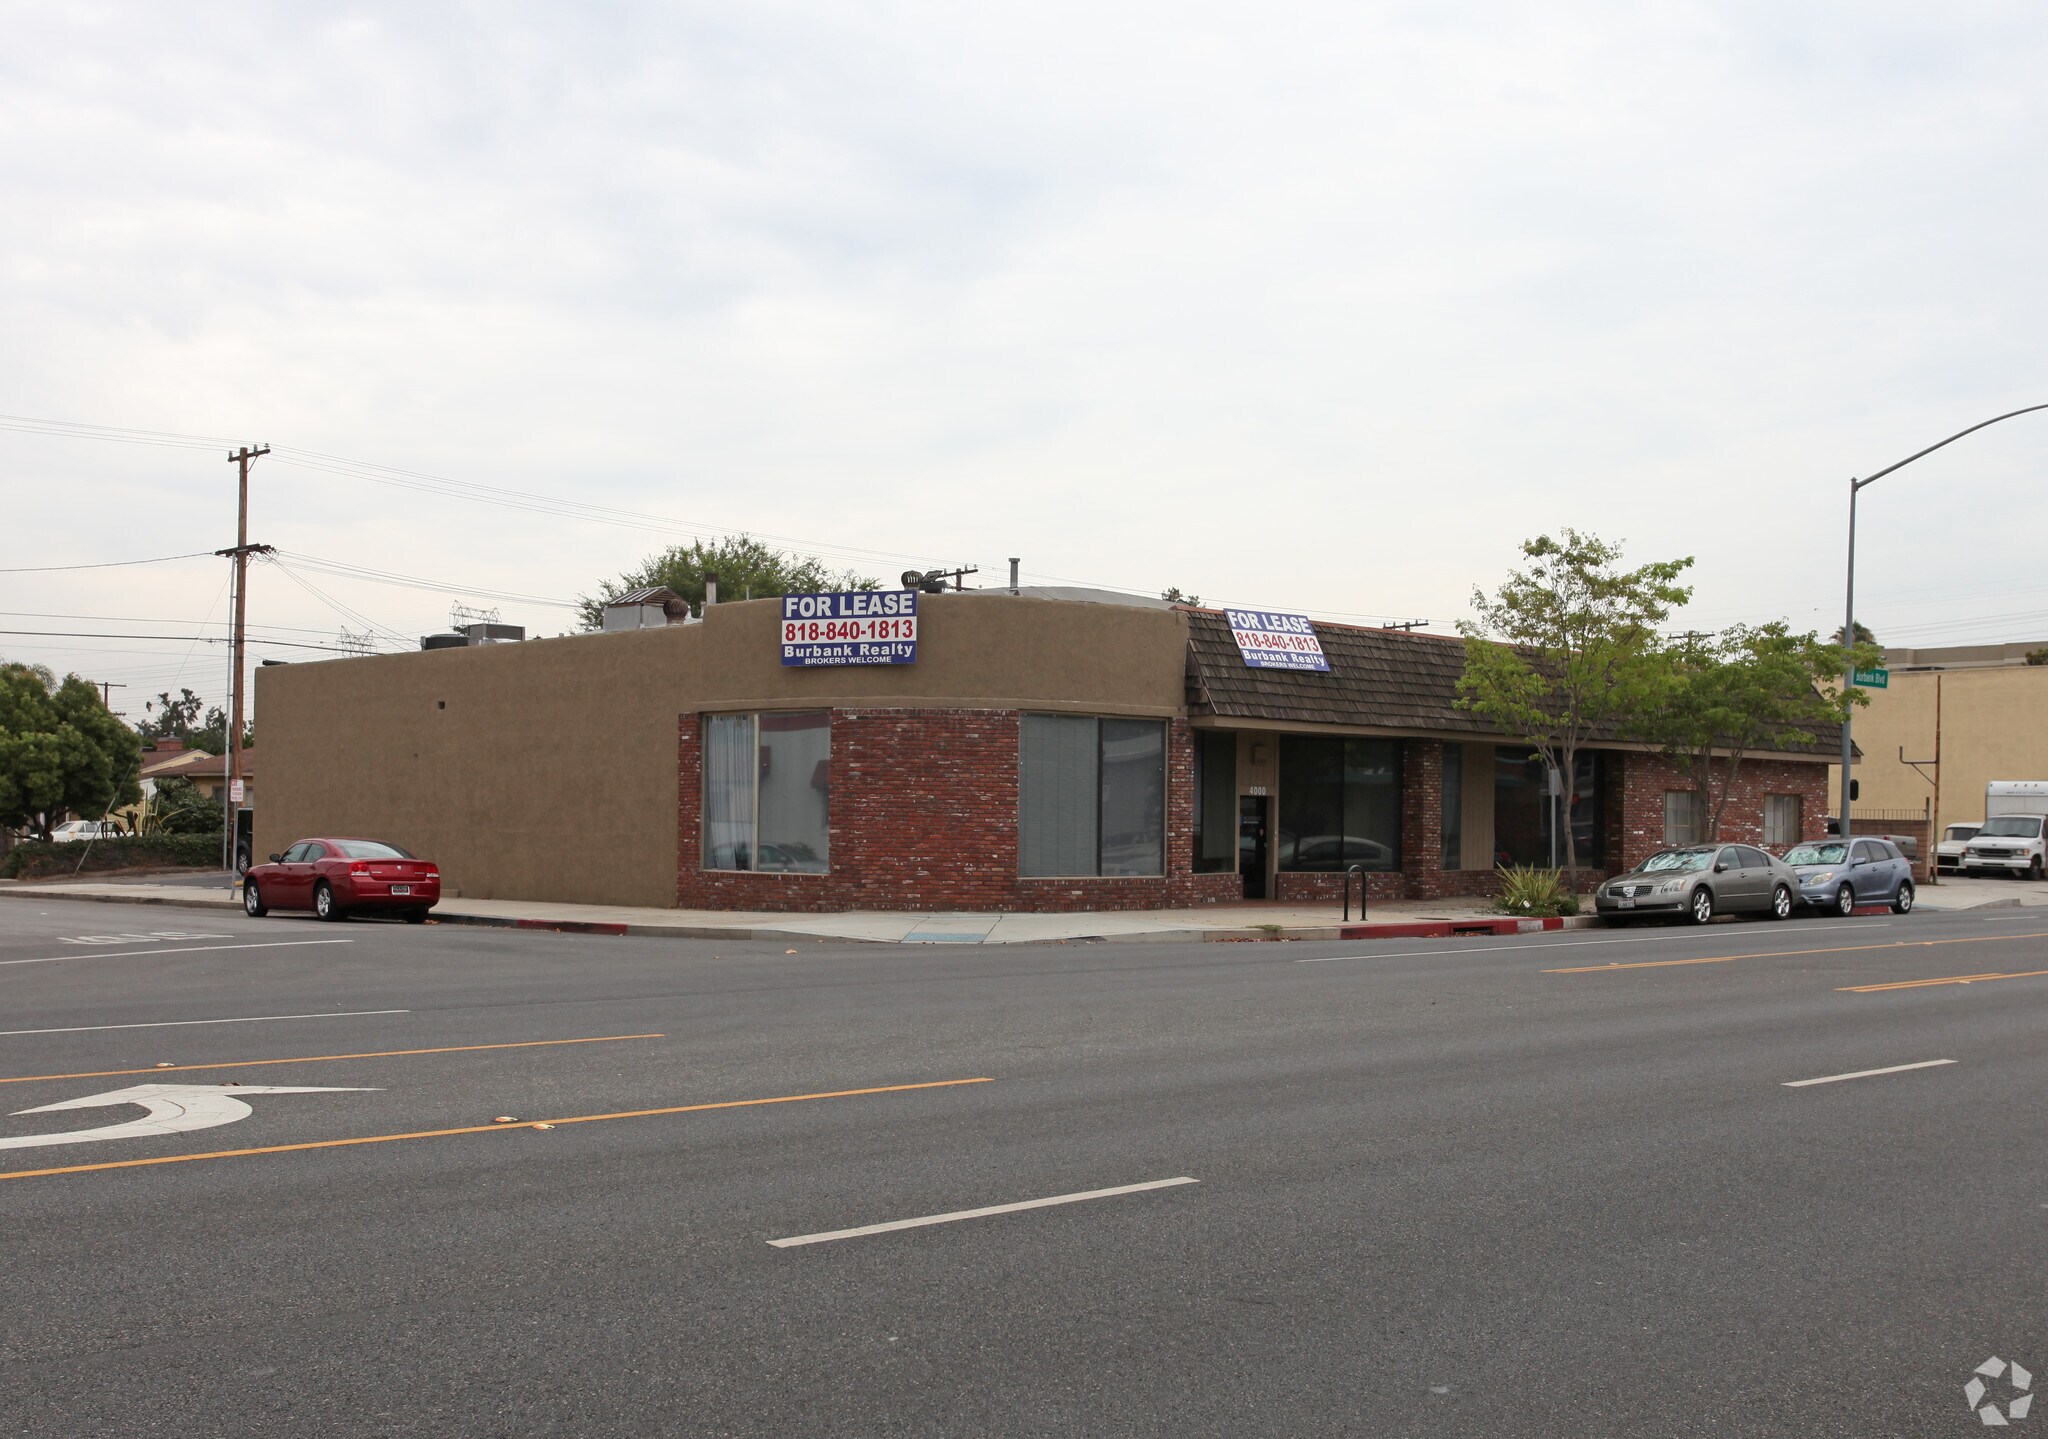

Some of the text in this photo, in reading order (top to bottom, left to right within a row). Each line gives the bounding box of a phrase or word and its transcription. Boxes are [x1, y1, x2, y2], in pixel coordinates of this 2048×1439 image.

[786, 594, 913, 617] FOR LEASE
[785, 620, 913, 641] 818-840-1813
[1227, 611, 1311, 633] FOR LEASE
[784, 643, 913, 657] Burbank Realty
[1236, 632, 1319, 652] 818-840-1813
[1243, 650, 1325, 666] Burbank Realty
[1249, 786, 1267, 795] 4000
